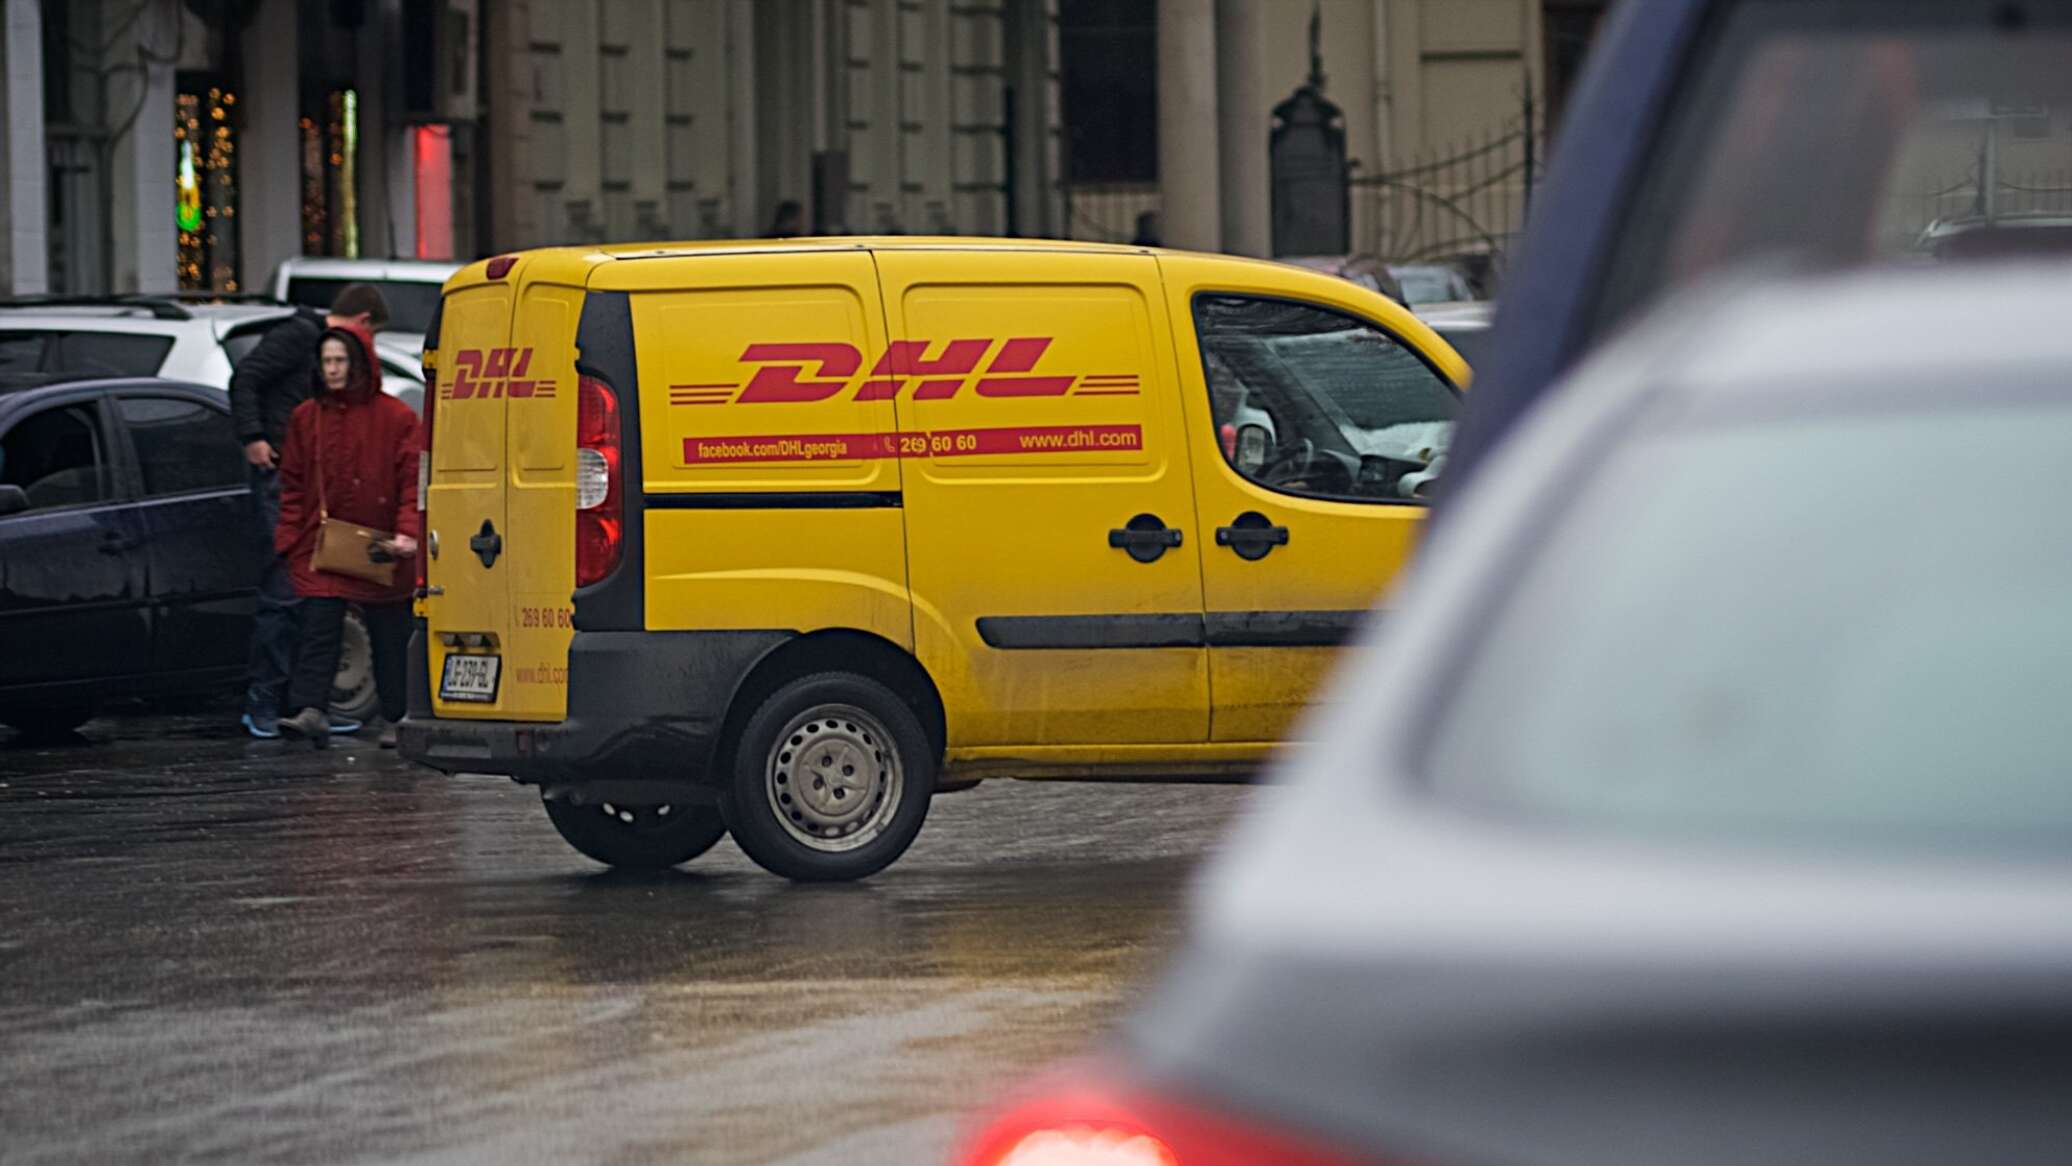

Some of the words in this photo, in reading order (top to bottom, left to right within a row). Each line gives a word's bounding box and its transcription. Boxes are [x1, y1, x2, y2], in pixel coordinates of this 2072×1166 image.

[451, 347, 537, 399] DHL
[735, 337, 1077, 404] DHL
[698, 439, 847, 459] facebook.com/DHLgeorgia
[900, 436, 926, 453] 269
[931, 435, 951, 453] 60
[956, 434, 977, 451] 60
[1019, 430, 1137, 449] www.dhl.com
[522, 607, 540, 628] 269
[542, 607, 554, 628] 60
[558, 607, 571, 628] 60
